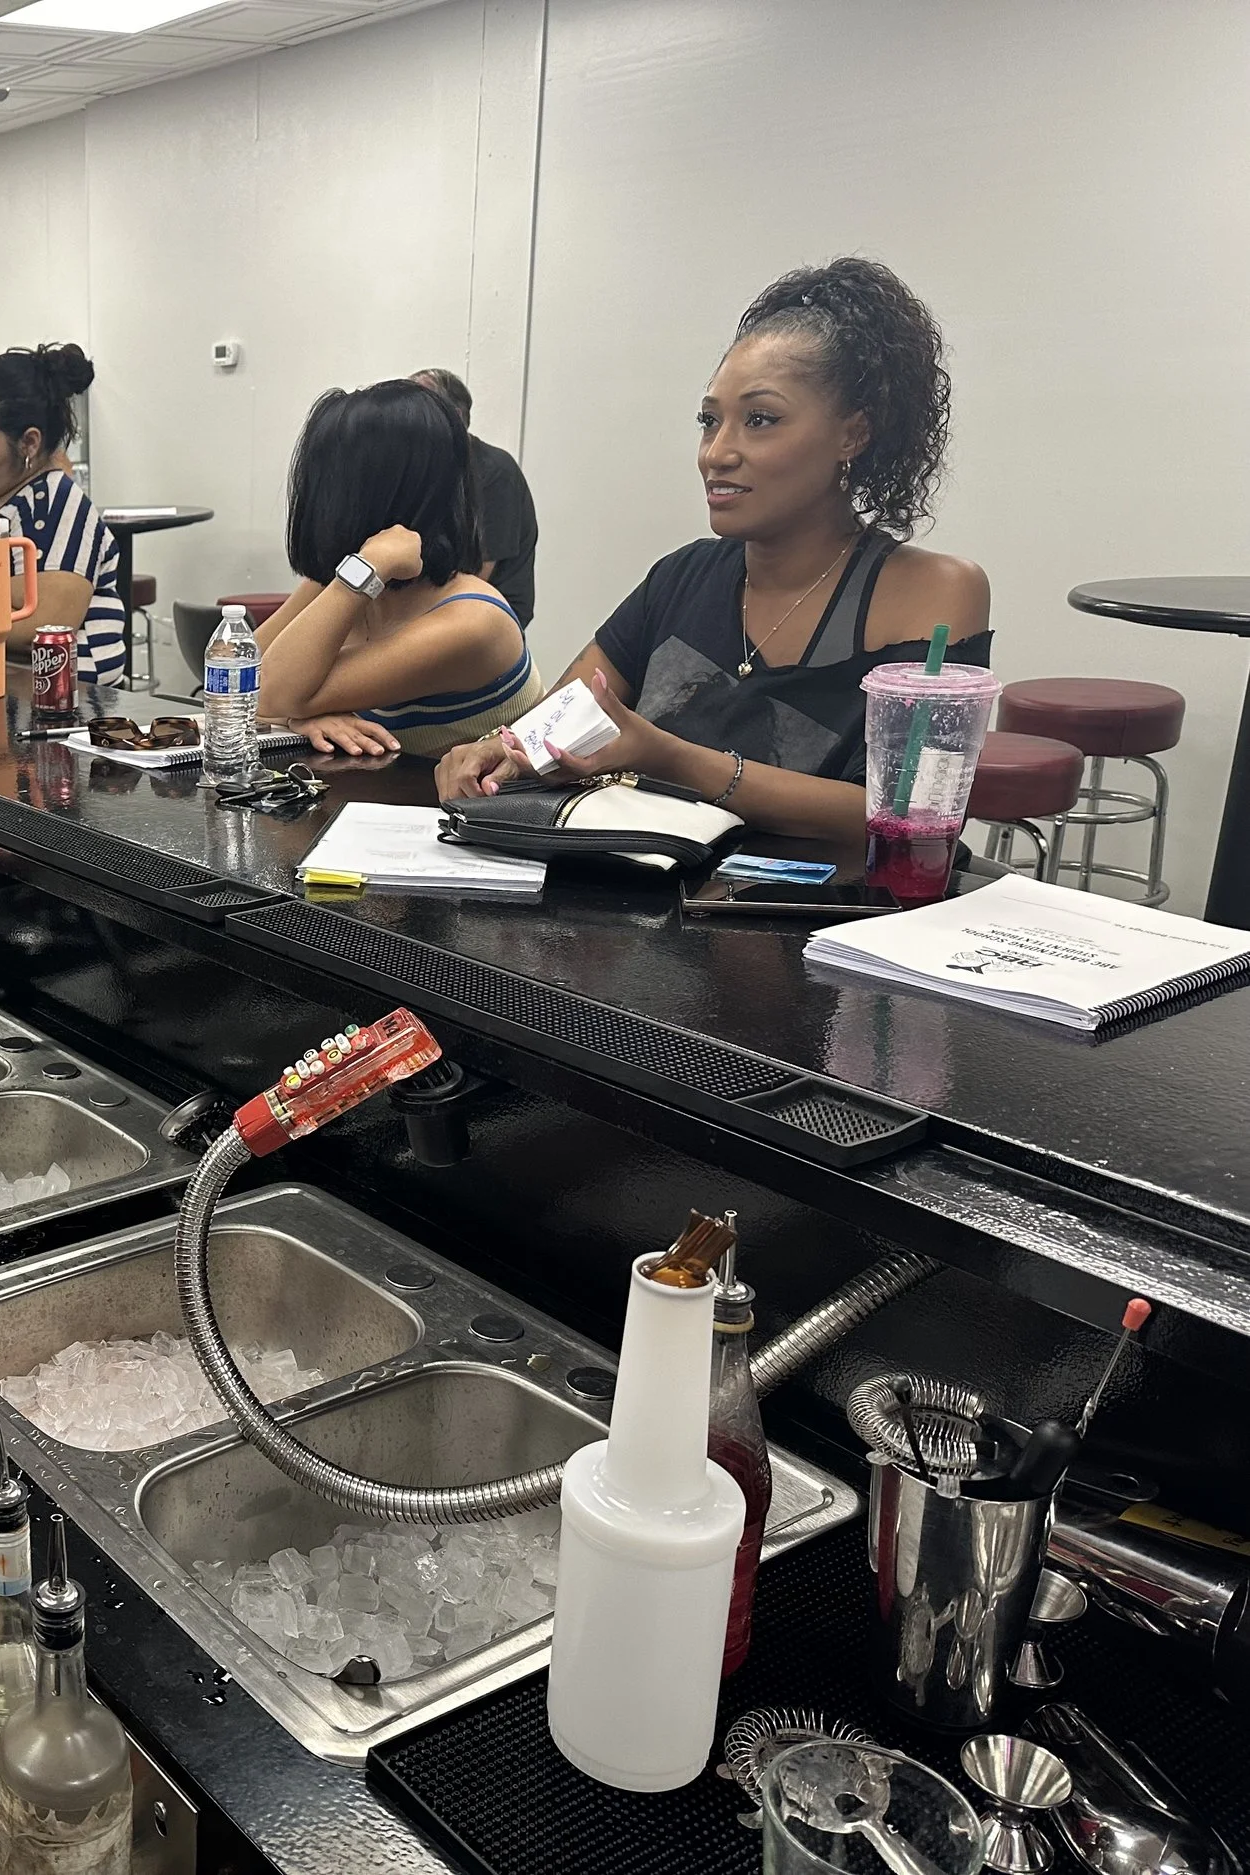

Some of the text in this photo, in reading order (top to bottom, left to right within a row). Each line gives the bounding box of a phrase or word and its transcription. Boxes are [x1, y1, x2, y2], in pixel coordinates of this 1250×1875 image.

[37, 647, 54, 659] Dr
[961, 927, 1008, 943] SCHOOL
[975, 949, 1044, 967] ABC
[1007, 941, 1090, 963] BARTENDING
[1048, 943, 1098, 958] STUDENT
[1090, 960, 1121, 970] ABC
